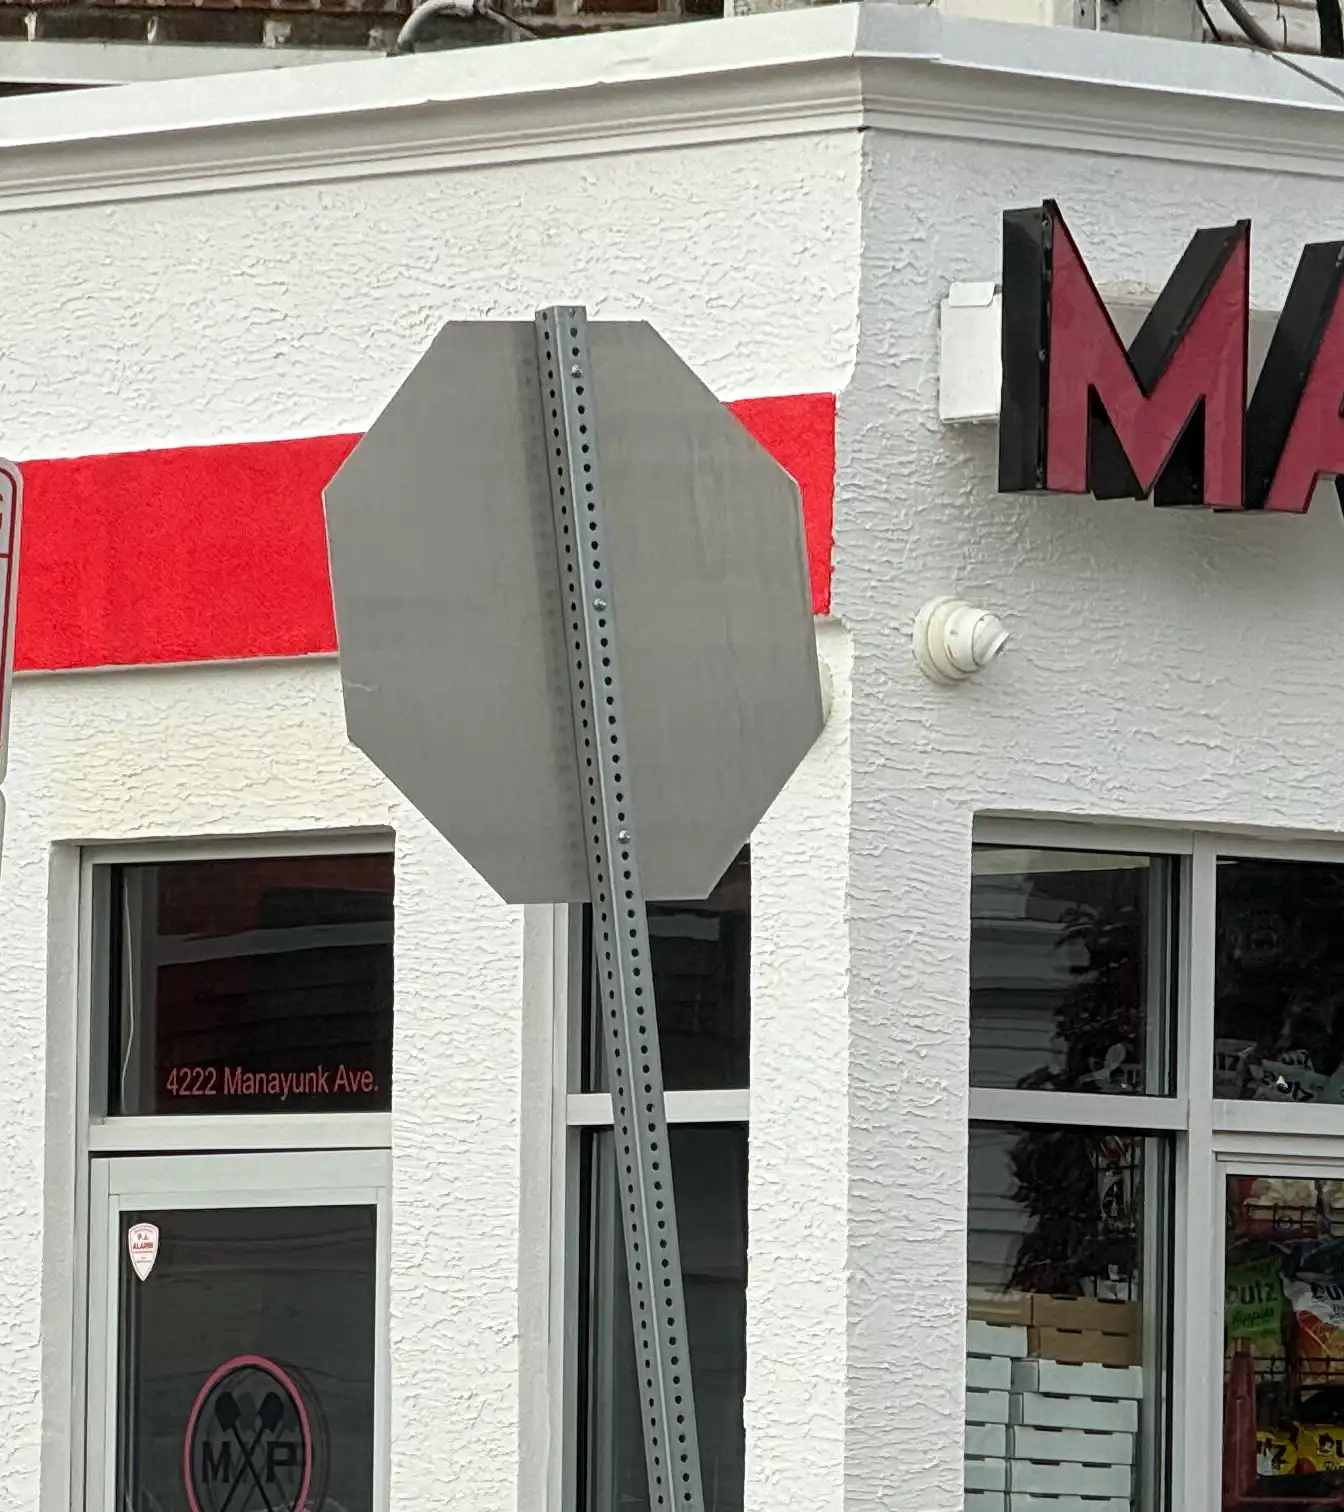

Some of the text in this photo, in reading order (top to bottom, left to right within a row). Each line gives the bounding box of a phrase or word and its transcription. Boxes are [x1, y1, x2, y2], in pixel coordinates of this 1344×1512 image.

[167, 1063, 379, 1100] 4222 Manayunk Ave.
